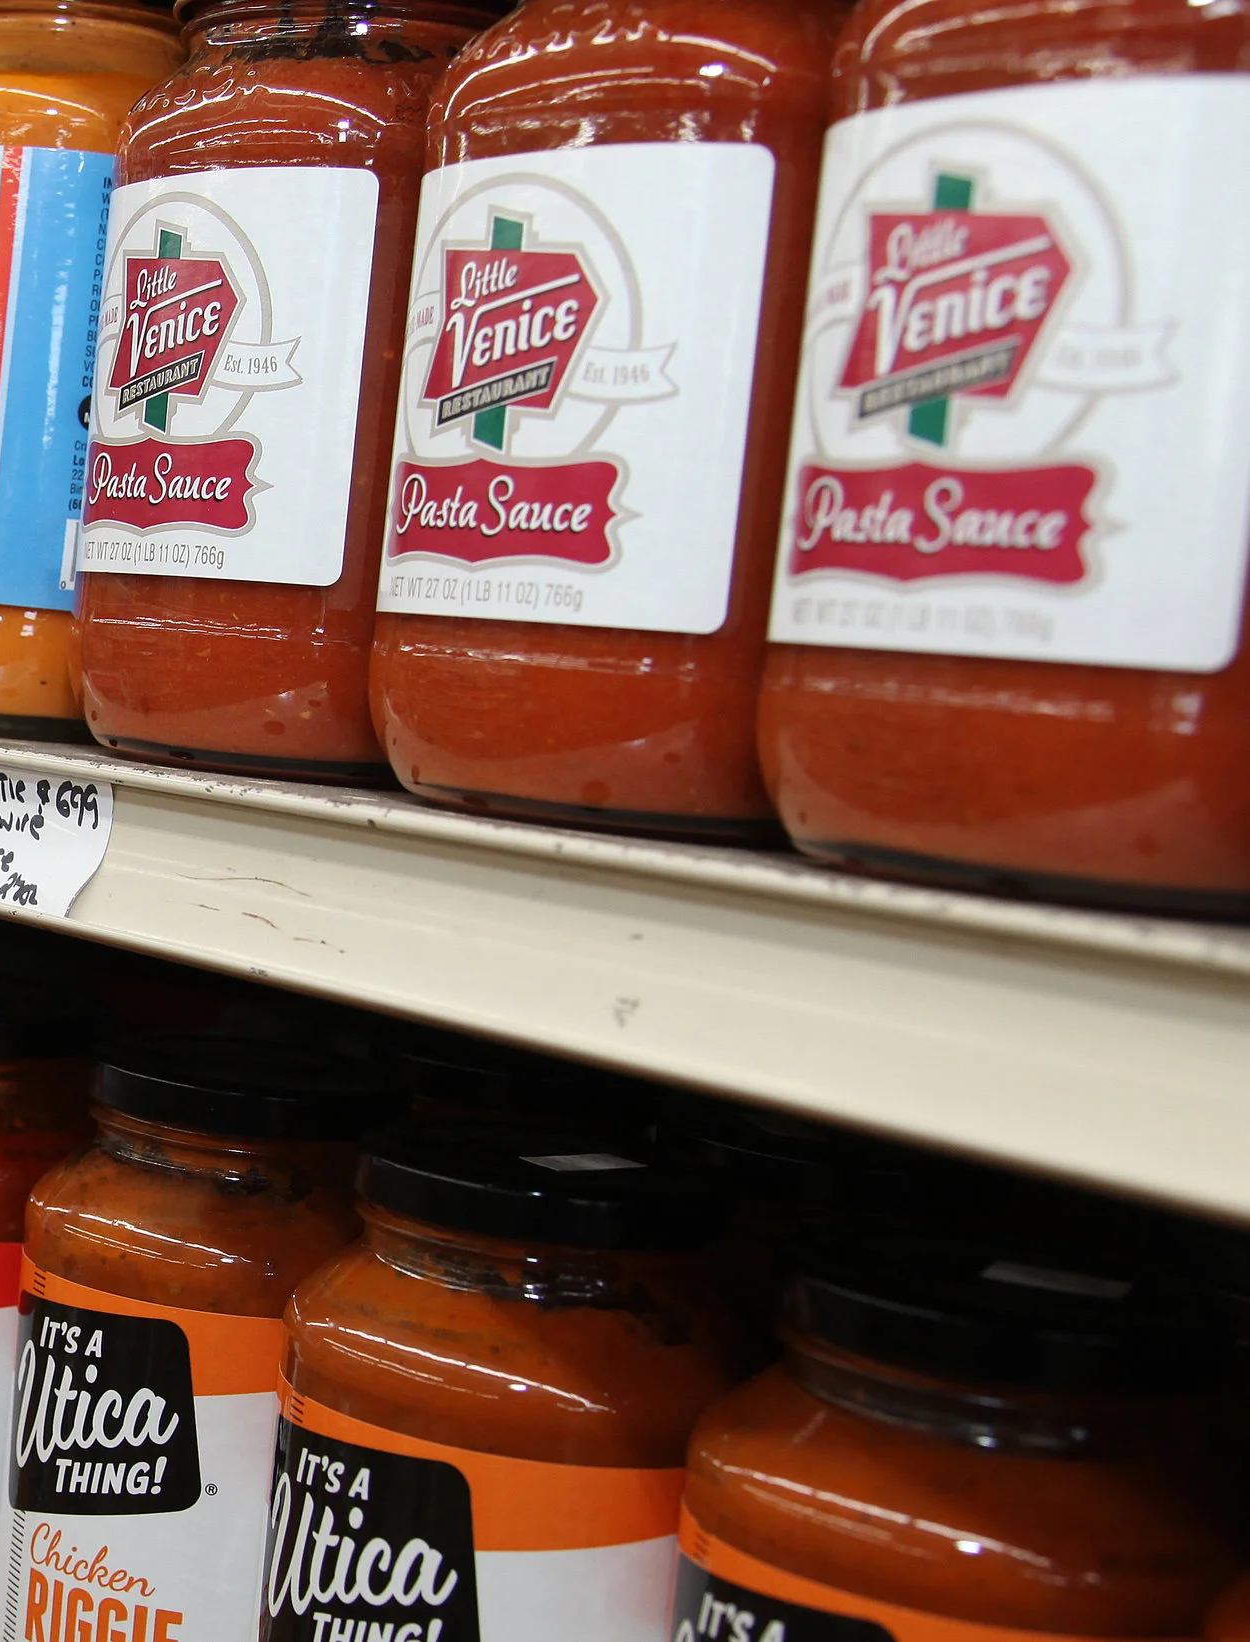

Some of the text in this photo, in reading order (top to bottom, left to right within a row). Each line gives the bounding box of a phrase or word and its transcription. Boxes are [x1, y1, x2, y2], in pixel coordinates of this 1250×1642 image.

[130, 264, 177, 310] Little
[450, 257, 518, 310] Little
[122, 357, 200, 404] RESTAURANT
[224, 354, 278, 375] Est. 1946
[614, 364, 649, 386] 1946
[441, 369, 550, 419] RESTAURANT
[88, 450, 147, 505] Pasta
[149, 452, 232, 505] Sauce
[397, 473, 592, 537] Pasta Sauce
[798, 475, 1068, 553] Pasta Sauce
[97, 542, 109, 560] WT
[110, 542, 120, 560] 27
[121, 542, 133, 561] OZ
[134, 542, 142, 566] (1
[144, 543, 155, 561] LB
[159, 544, 169, 562] 11
[172, 544, 190, 568] OZ)
[194, 545, 225, 570] 766g
[407, 577, 423, 598] WT
[425, 578, 440, 599] 27
[442, 578, 457, 600] OZ
[461, 579, 472, 606] (1
[475, 580, 491, 602] LB
[497, 581, 510, 603] 11
[515, 582, 540, 609] OZ)
[544, 584, 584, 612] 766g
[39, 1316, 103, 1358] IT'S A
[16, 1339, 180, 1468] Utica
[55, 1456, 168, 1495] THING!
[296, 1448, 371, 1501] IT'S A
[30, 1522, 156, 1597] Chicken
[268, 1471, 459, 1618] Utica
